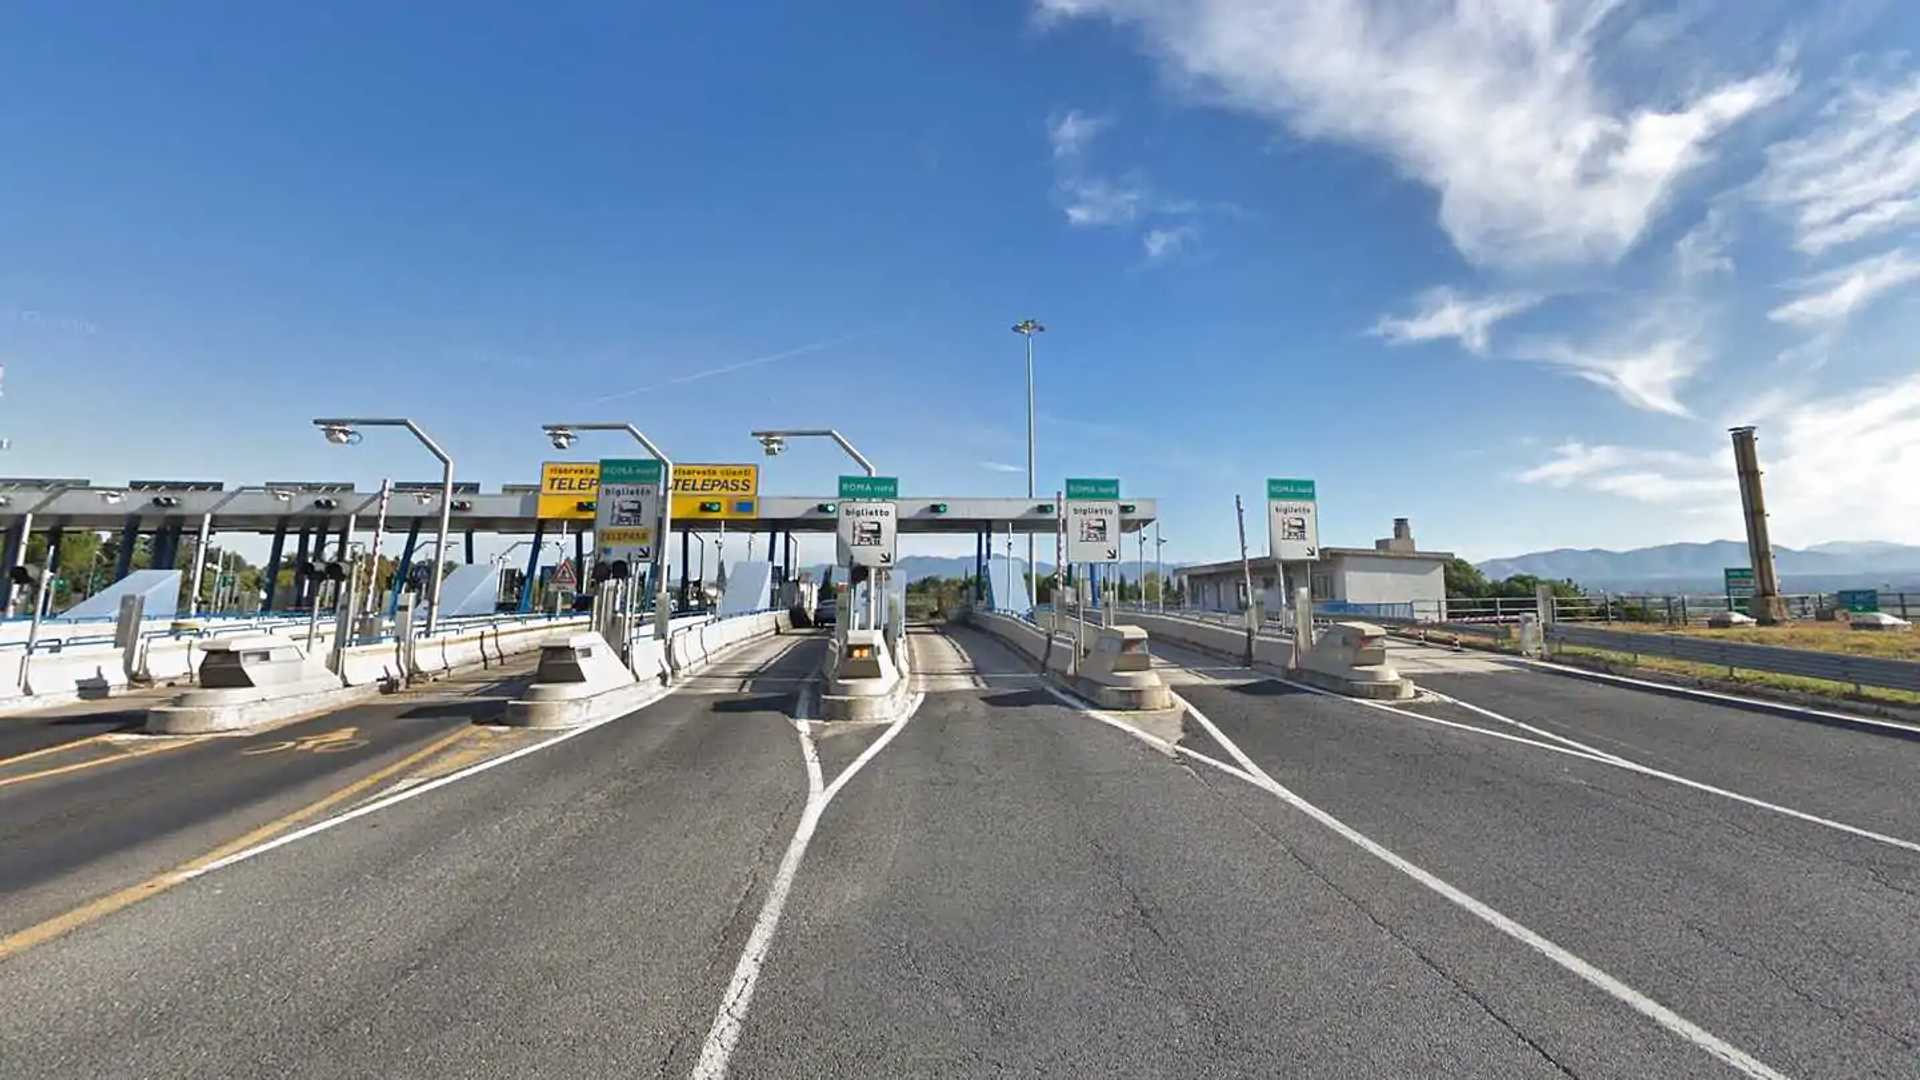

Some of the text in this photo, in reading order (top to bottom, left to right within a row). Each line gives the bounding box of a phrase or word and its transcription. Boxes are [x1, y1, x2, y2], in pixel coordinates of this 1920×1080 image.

[549, 477, 600, 491] TELEP
[672, 478, 751, 492] TELEPASS
[842, 482, 872, 492] ROMA
[845, 507, 889, 518] biglietto
[1073, 506, 1112, 516] biglietto
[1275, 505, 1311, 515] biglietto
